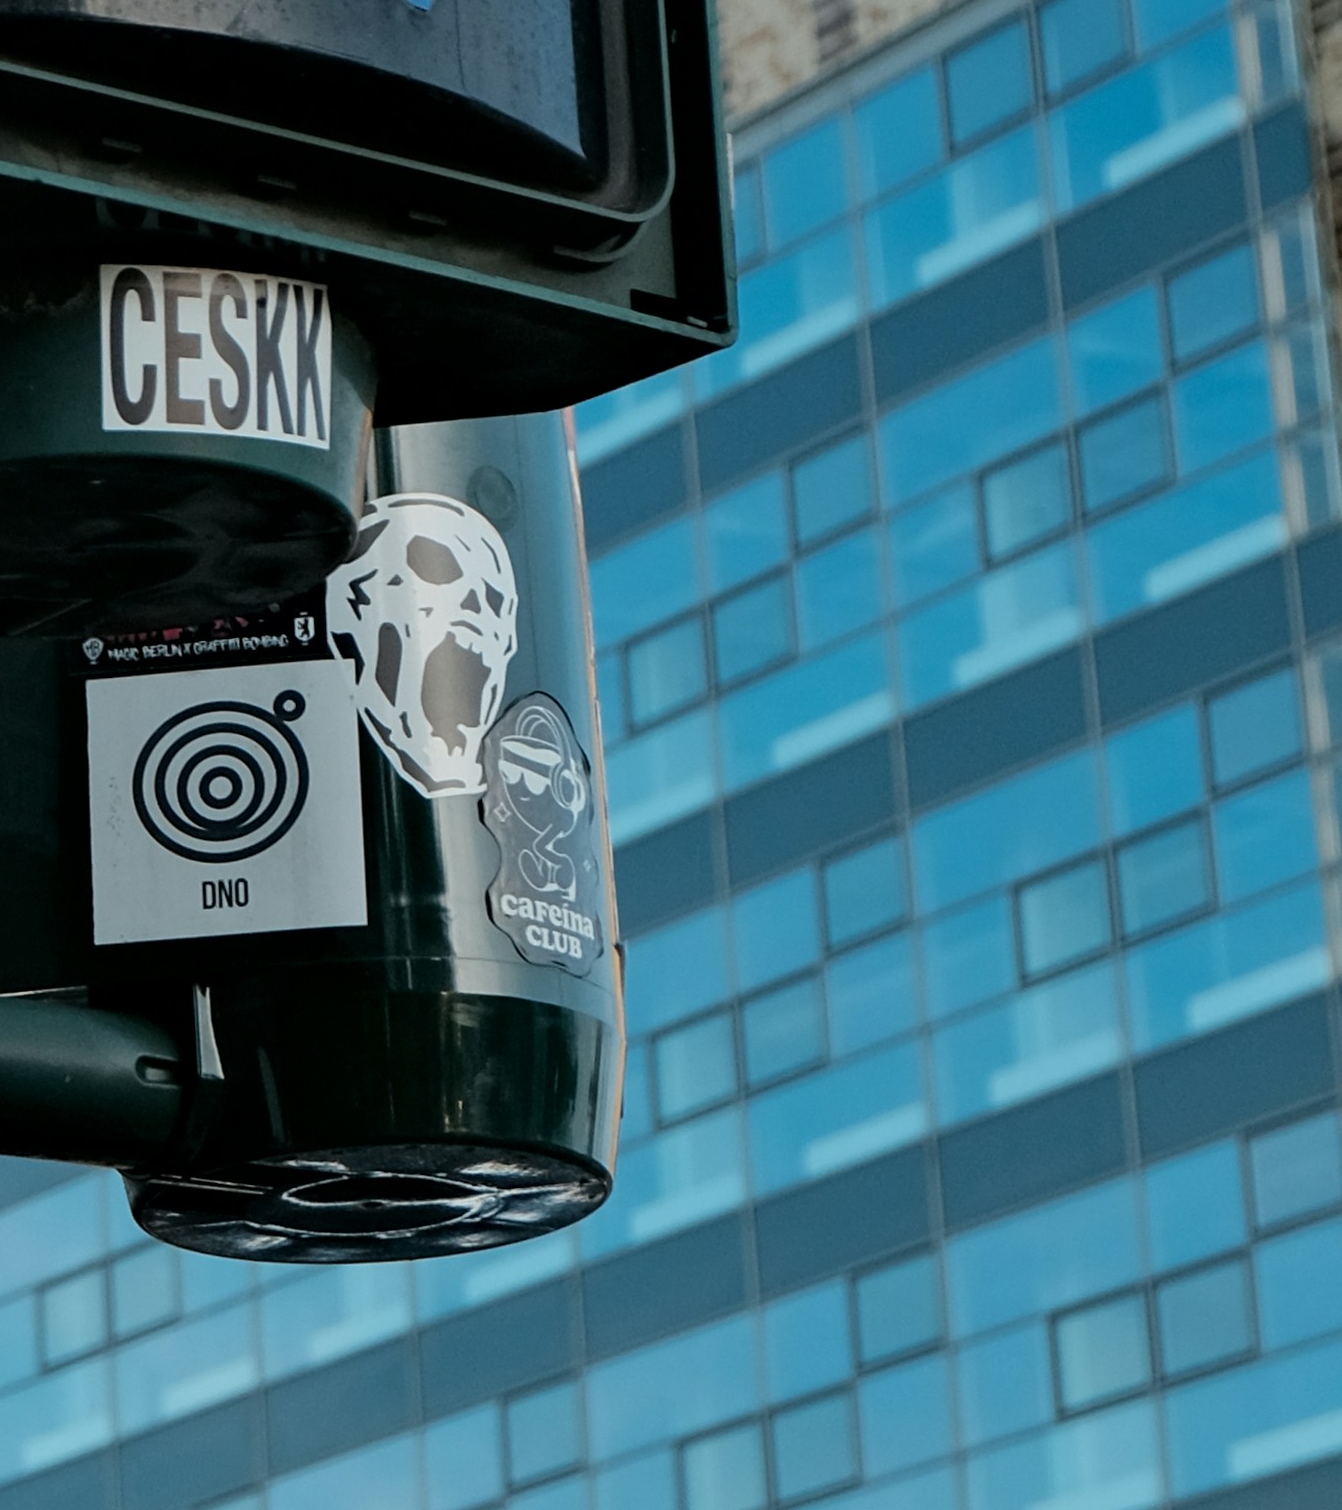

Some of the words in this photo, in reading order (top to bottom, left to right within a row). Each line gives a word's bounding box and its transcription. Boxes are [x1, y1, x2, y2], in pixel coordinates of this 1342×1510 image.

[109, 267, 329, 441] CESKK
[201, 878, 250, 911] DNO
[526, 924, 582, 959] CLUB
